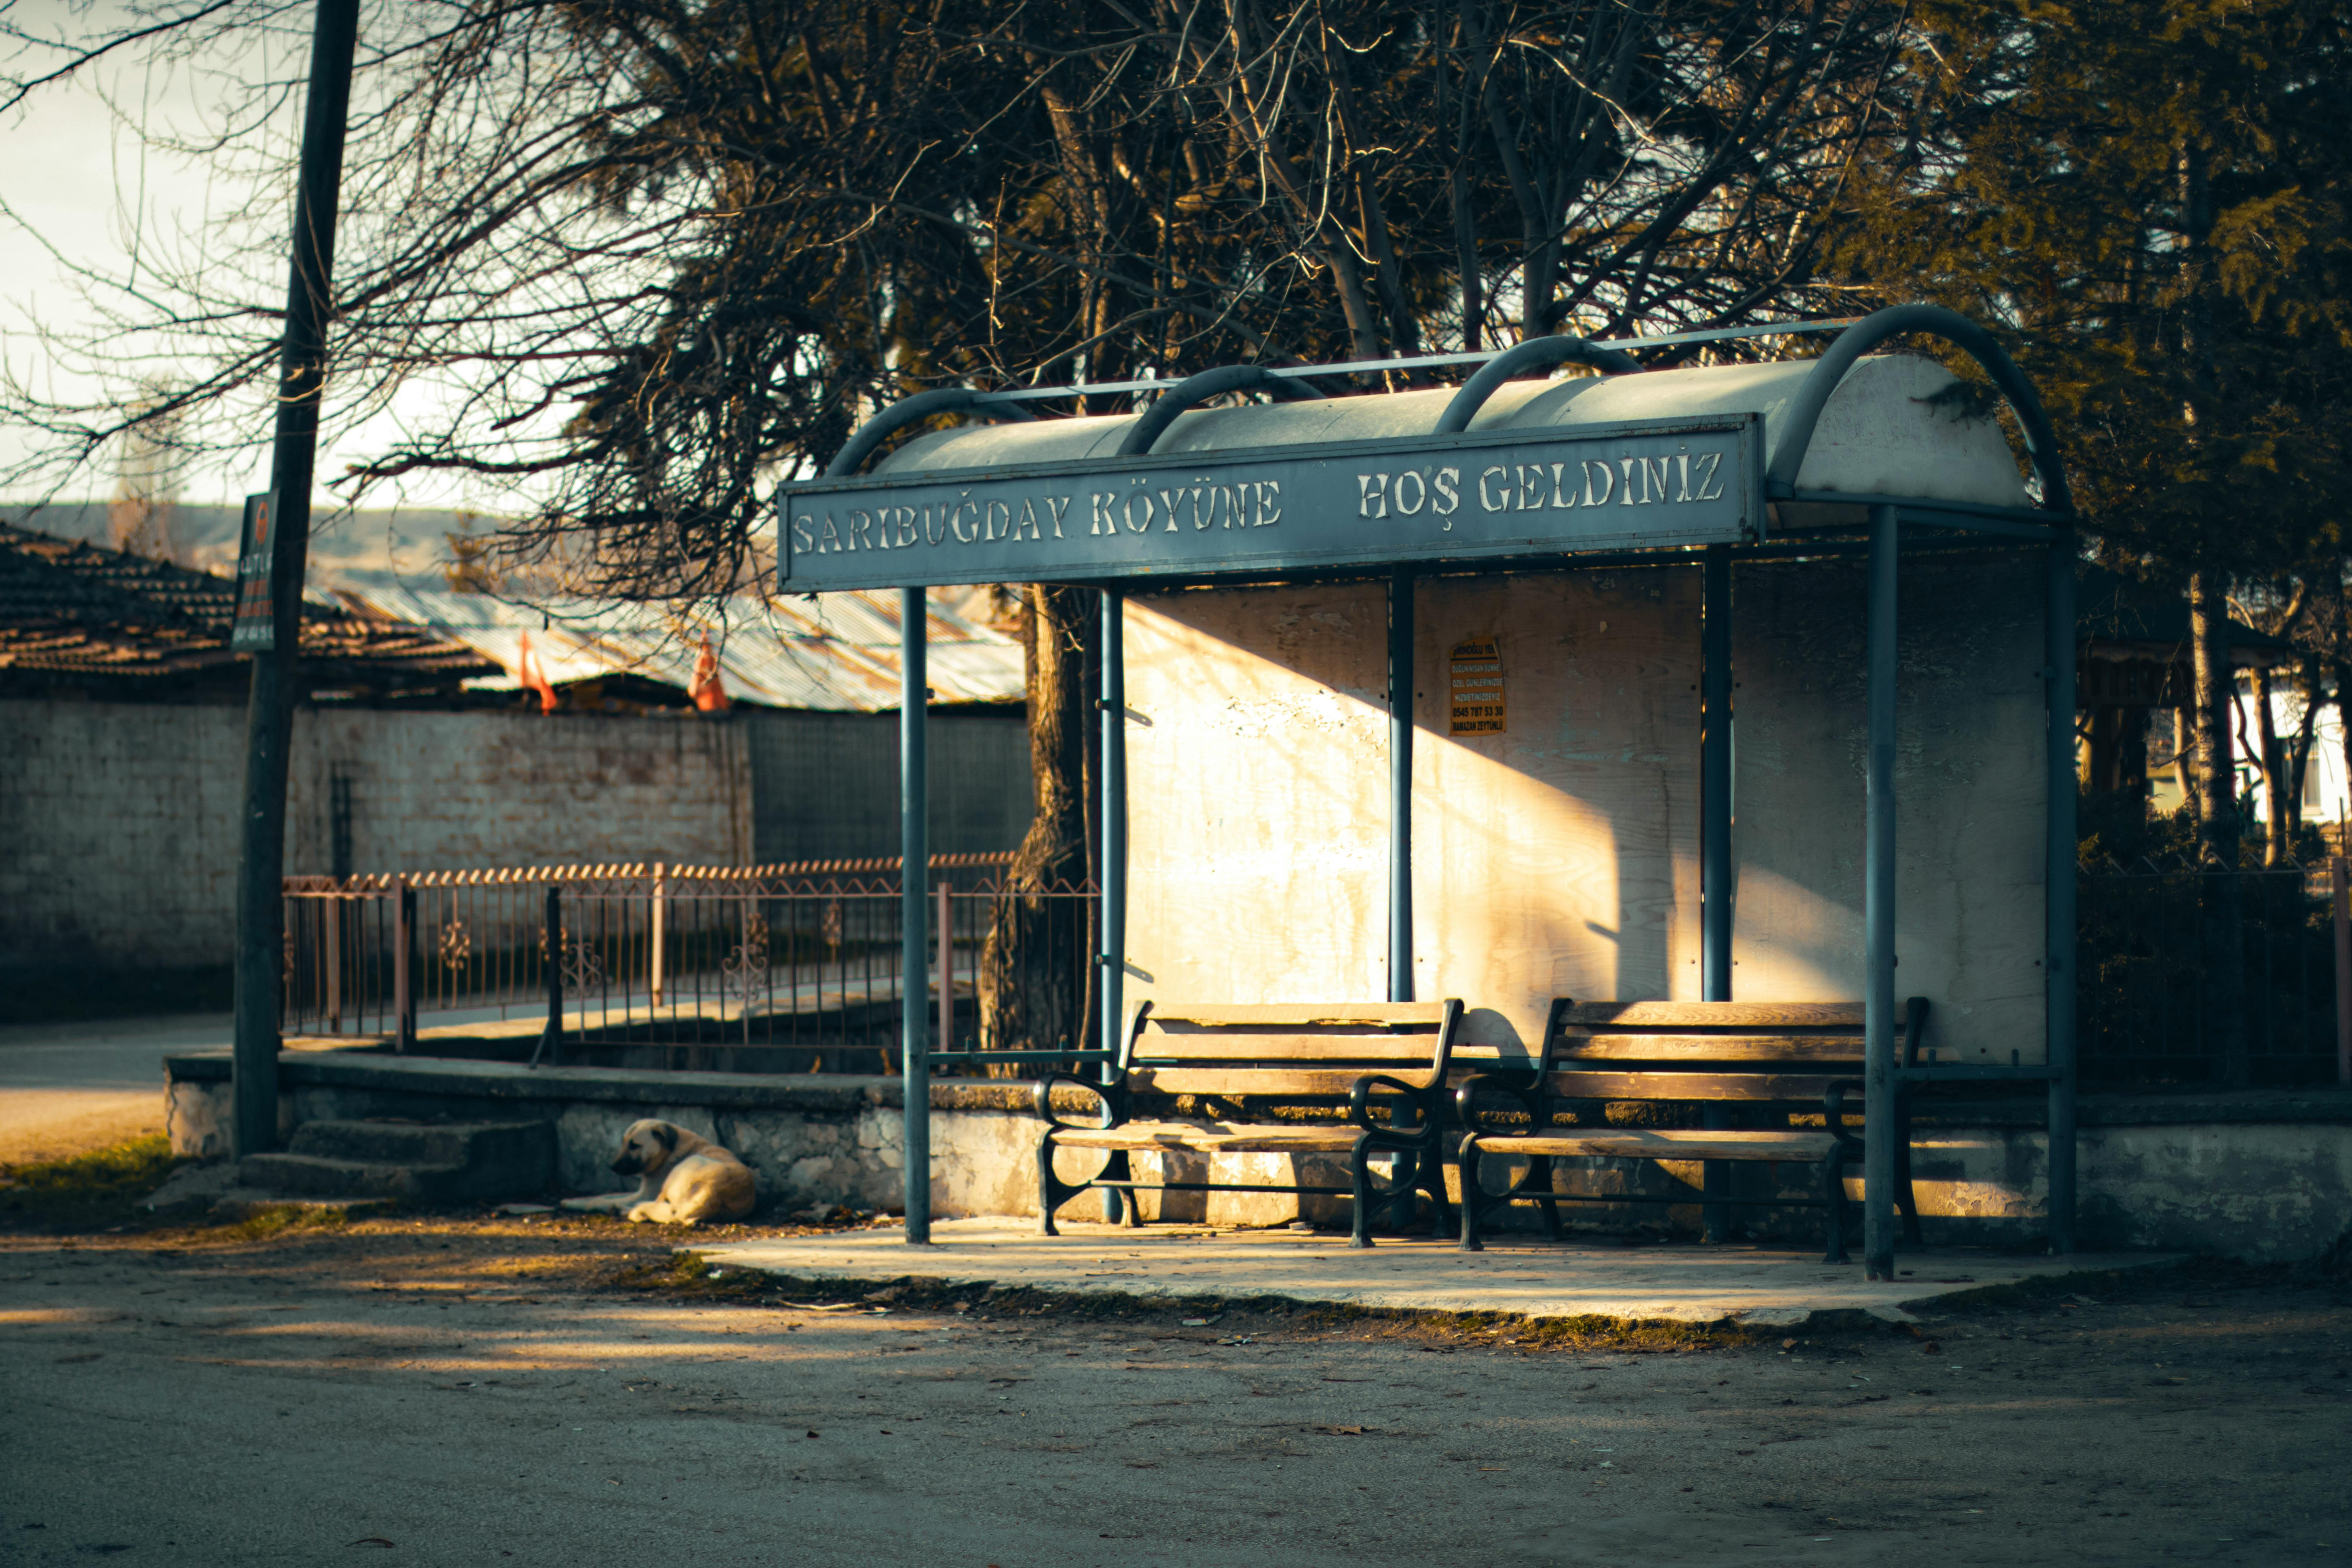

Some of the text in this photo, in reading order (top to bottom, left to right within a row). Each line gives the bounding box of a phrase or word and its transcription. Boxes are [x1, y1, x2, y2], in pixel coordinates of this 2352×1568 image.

[793, 445, 1725, 554] SARIBUĞDAY KÖYÜNE HOŞ GELDİNİZ
[1453, 705, 1504, 717] 0545 787 53 30
[1453, 721, 1476, 731] RAMAZAN
